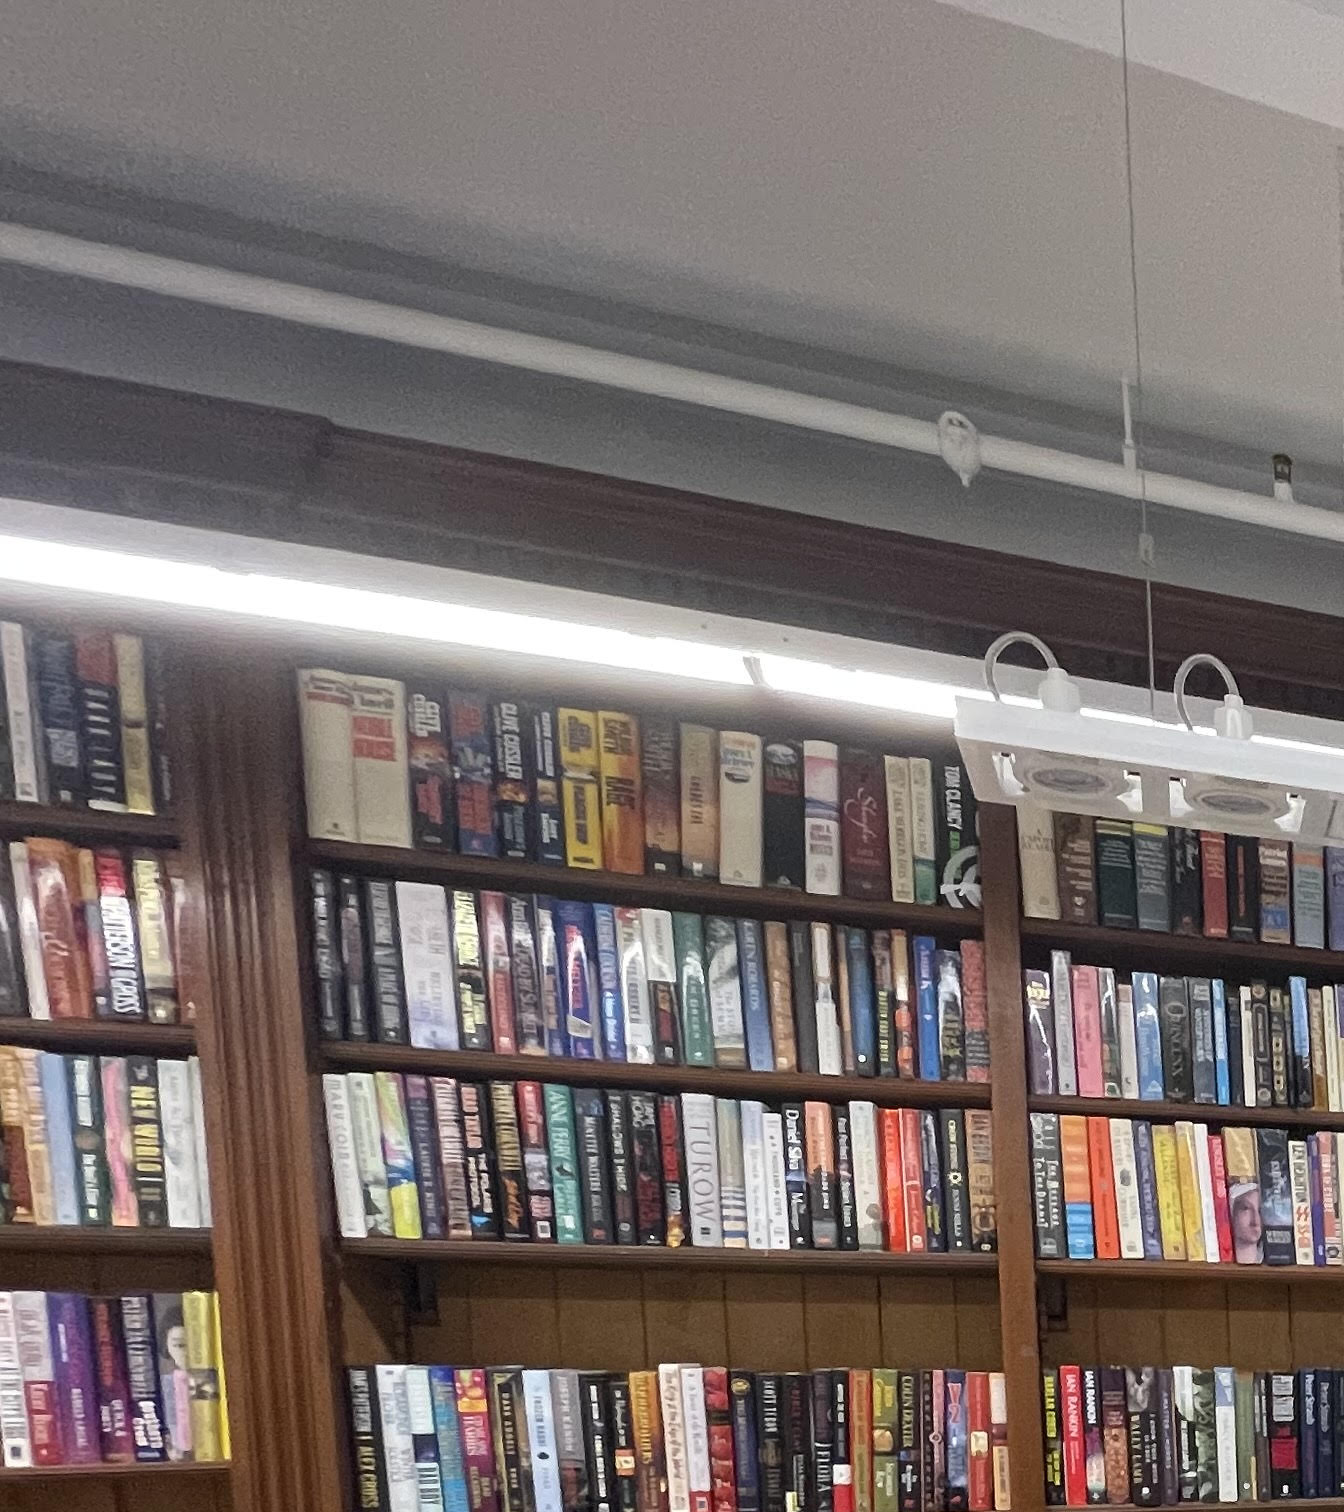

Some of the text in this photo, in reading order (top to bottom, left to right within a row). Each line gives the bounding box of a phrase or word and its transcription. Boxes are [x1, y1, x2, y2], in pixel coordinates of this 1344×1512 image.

[934, 790, 953, 830] CLANCY
[786, 1109, 803, 1170] Daniel Silva
[688, 1121, 716, 1221] TUROW
[901, 1375, 915, 1448] COLIN DEXTER
[1066, 1374, 1080, 1437] IAN RANKIN
[1084, 1370, 1098, 1424] IAN RANKIN
[359, 1446, 380, 1508] ALEX CROSS
